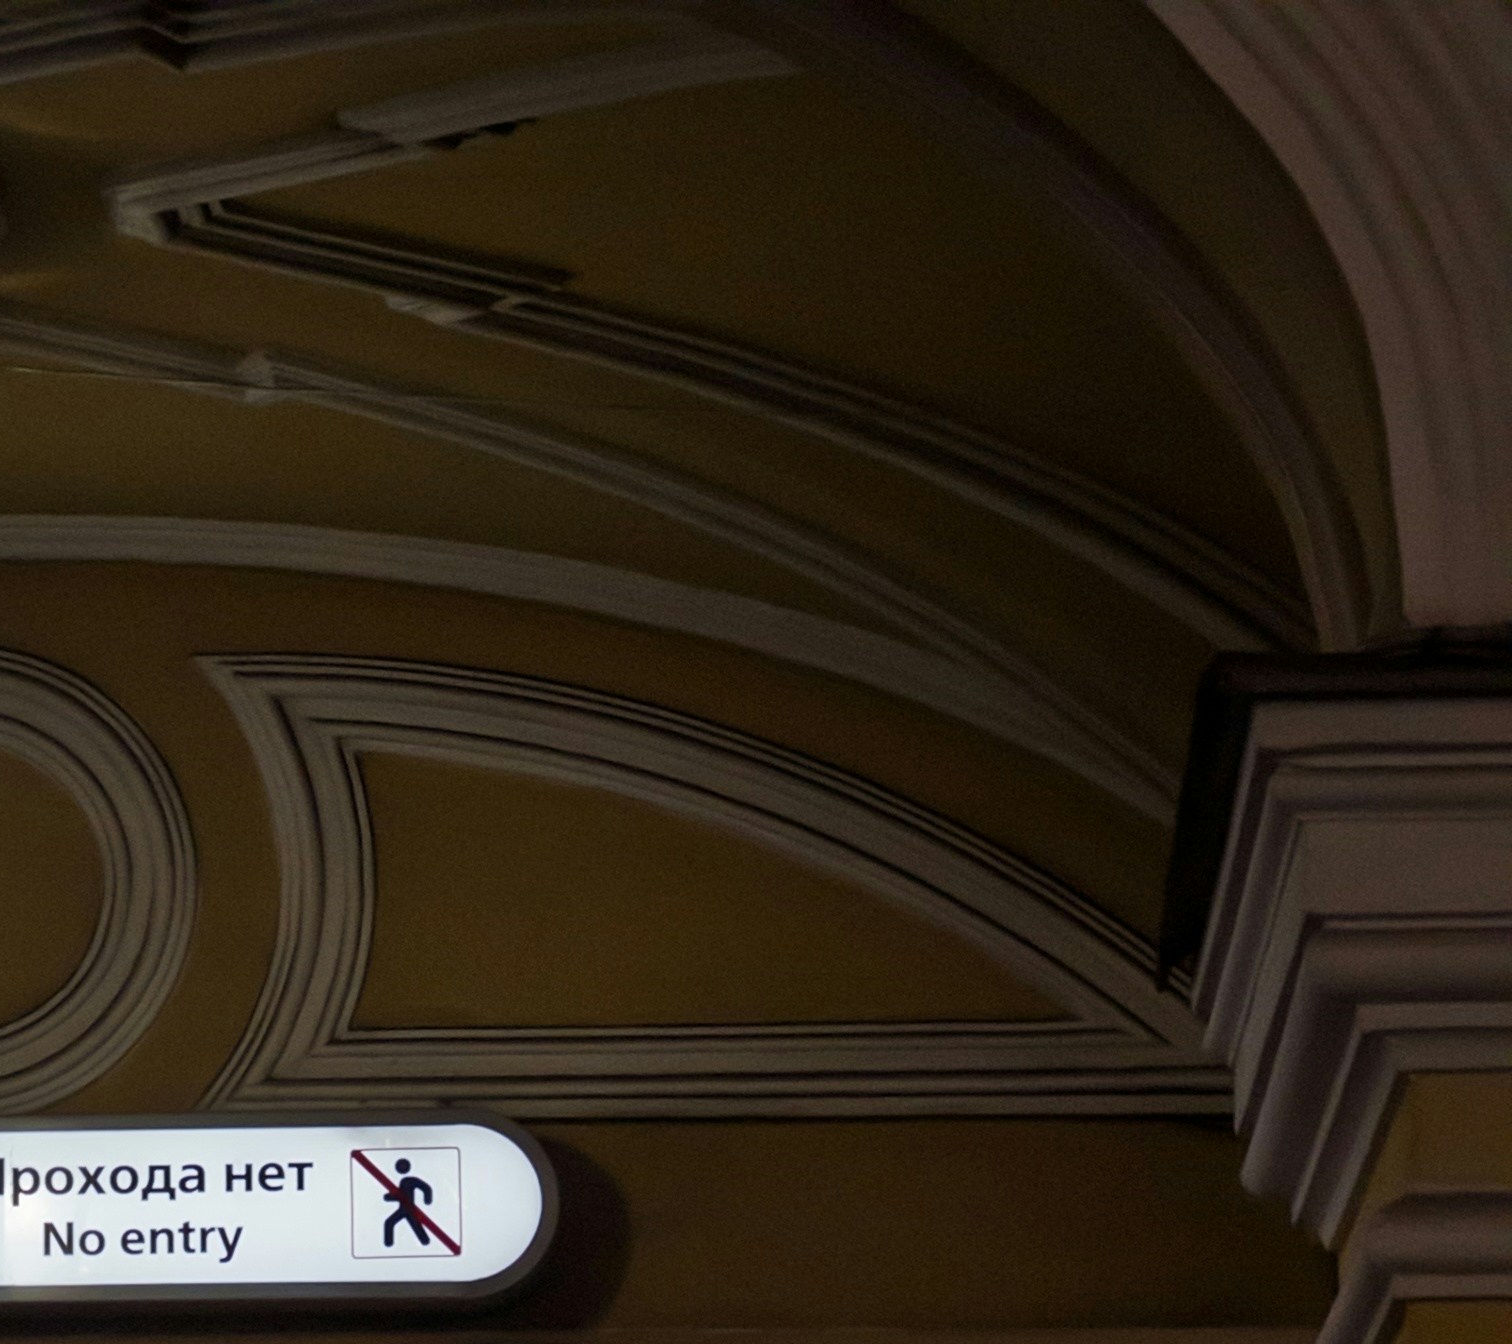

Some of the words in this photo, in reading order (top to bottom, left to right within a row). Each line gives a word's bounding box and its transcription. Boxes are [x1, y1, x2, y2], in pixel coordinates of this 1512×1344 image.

[225, 1162, 314, 1193] нет
[44, 1222, 106, 1256] No
[120, 1221, 243, 1264] entry
